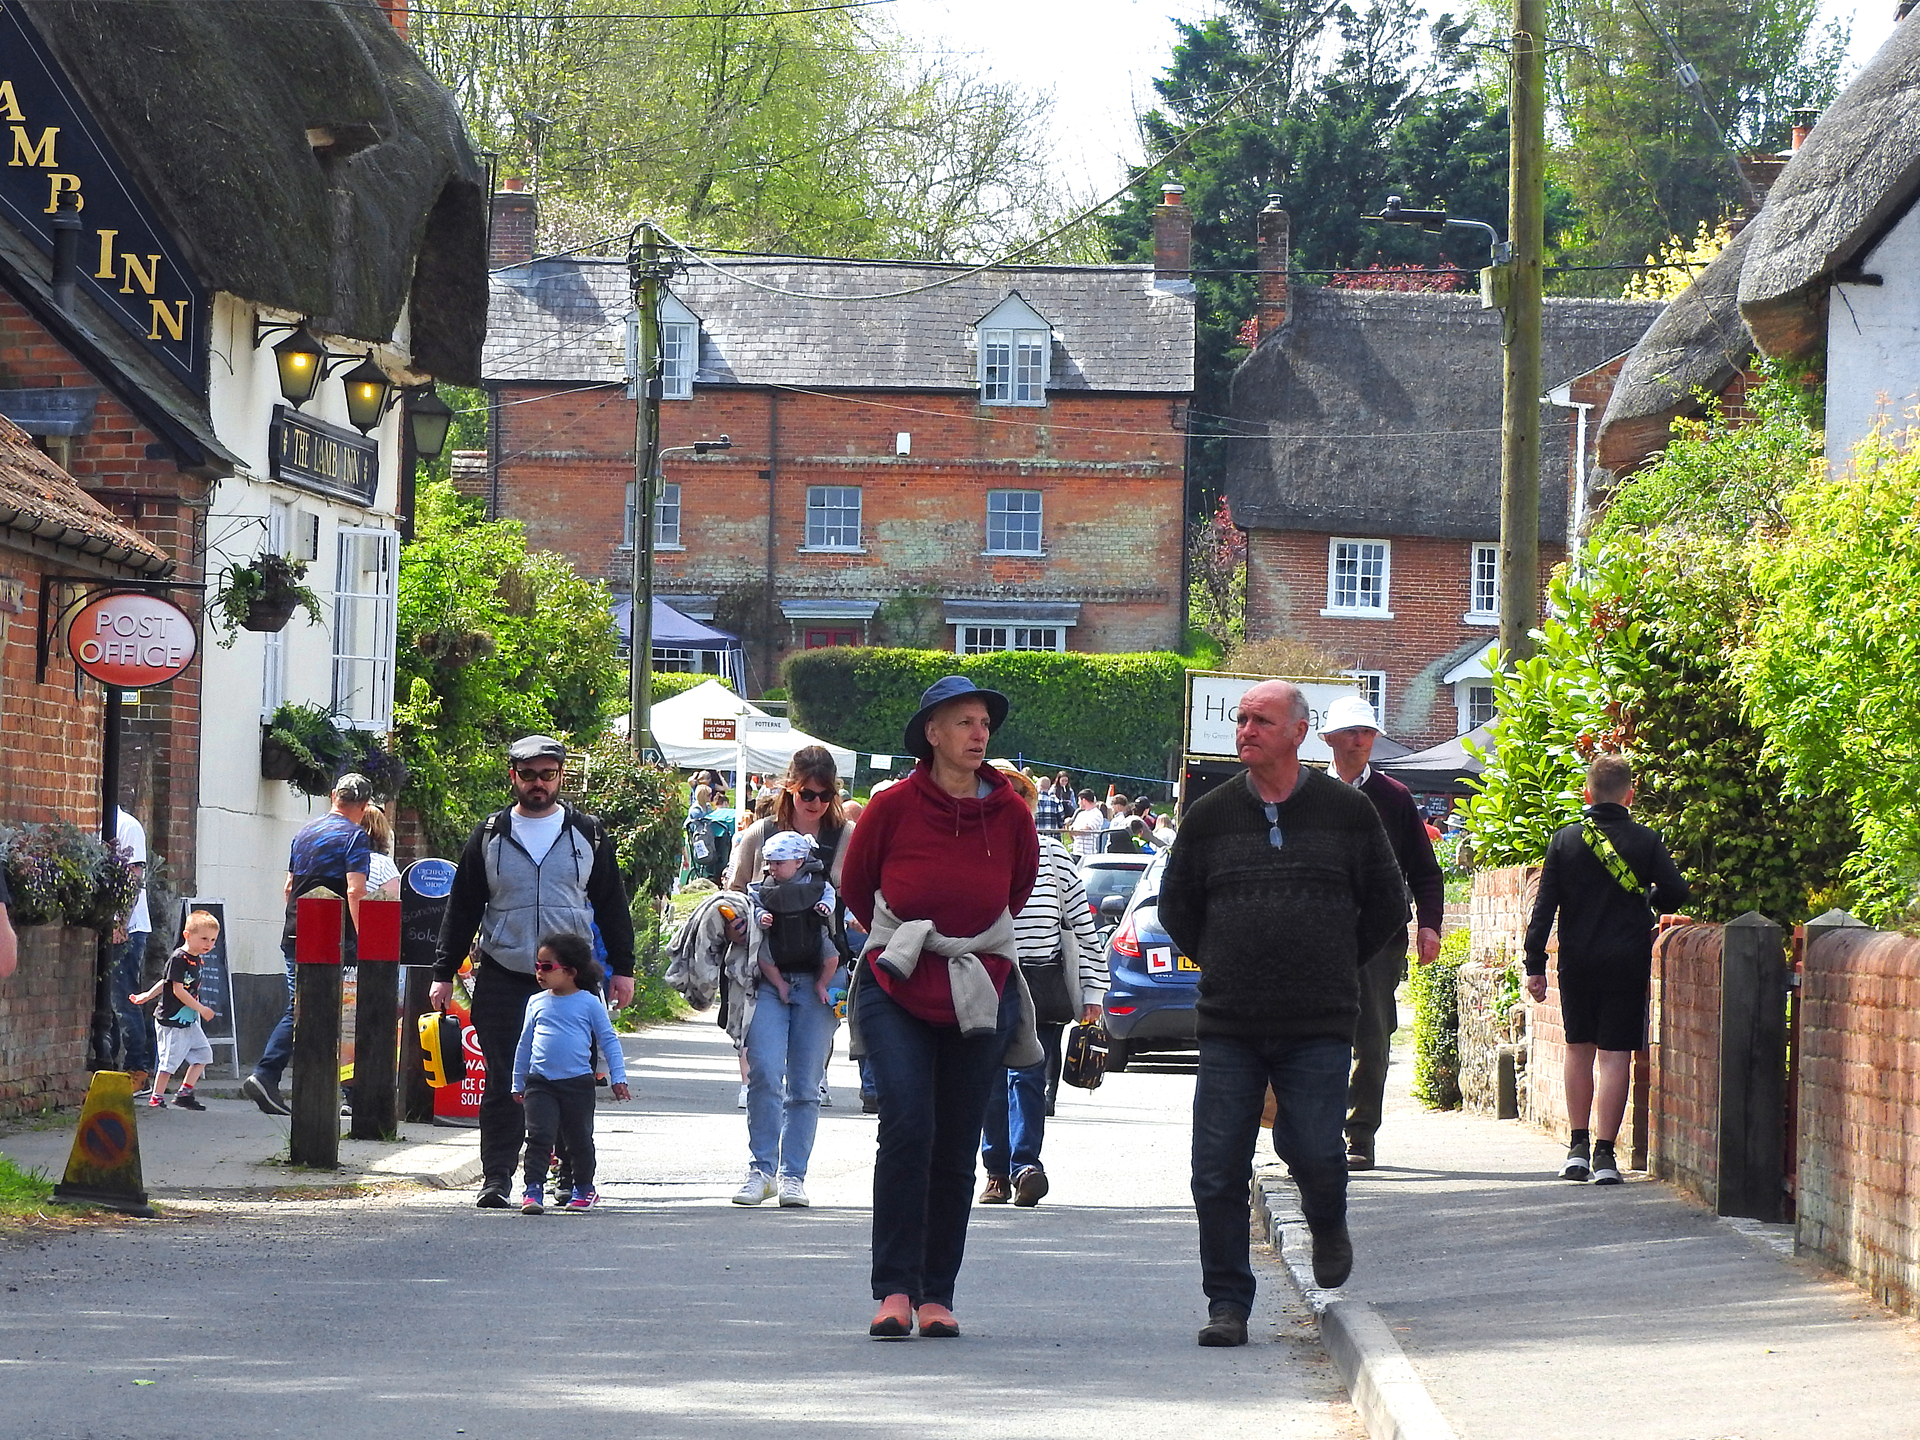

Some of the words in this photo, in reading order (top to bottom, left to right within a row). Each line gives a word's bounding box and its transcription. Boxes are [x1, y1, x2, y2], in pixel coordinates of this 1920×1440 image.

[94, 229, 188, 340] INN
[294, 428, 310, 469] THE
[313, 436, 338, 478] LAMB
[343, 446, 360, 485] INN
[96, 611, 174, 638] POST
[79, 639, 180, 668] OFFICE
[417, 868, 453, 876] URCHFONT
[1153, 954, 1165, 967] L
[461, 1077, 476, 1091] ICE
